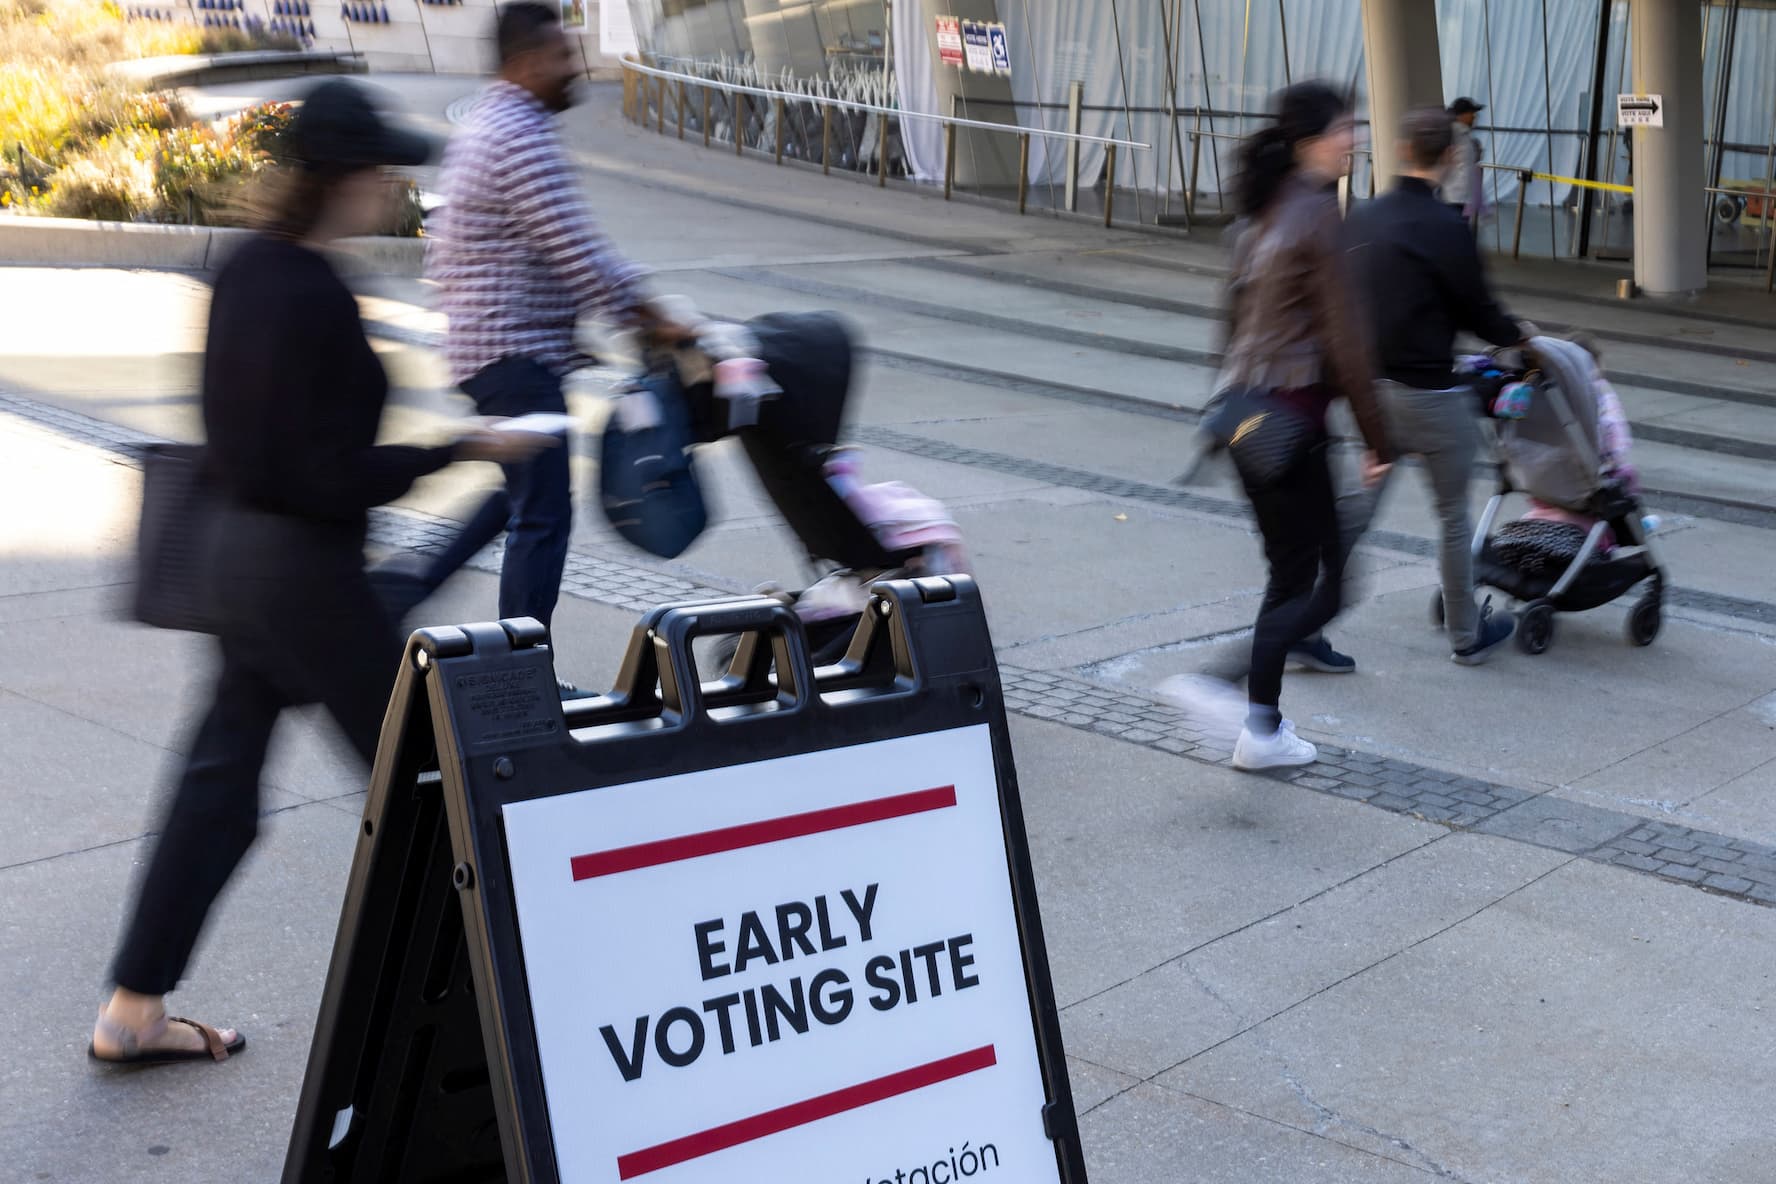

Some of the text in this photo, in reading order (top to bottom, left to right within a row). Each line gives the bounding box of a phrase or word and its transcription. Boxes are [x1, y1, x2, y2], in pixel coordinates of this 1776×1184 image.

[693, 882, 879, 982] EARLY
[598, 933, 980, 1083] VOTING SITE
[866, 1140, 1000, 1184] tación
